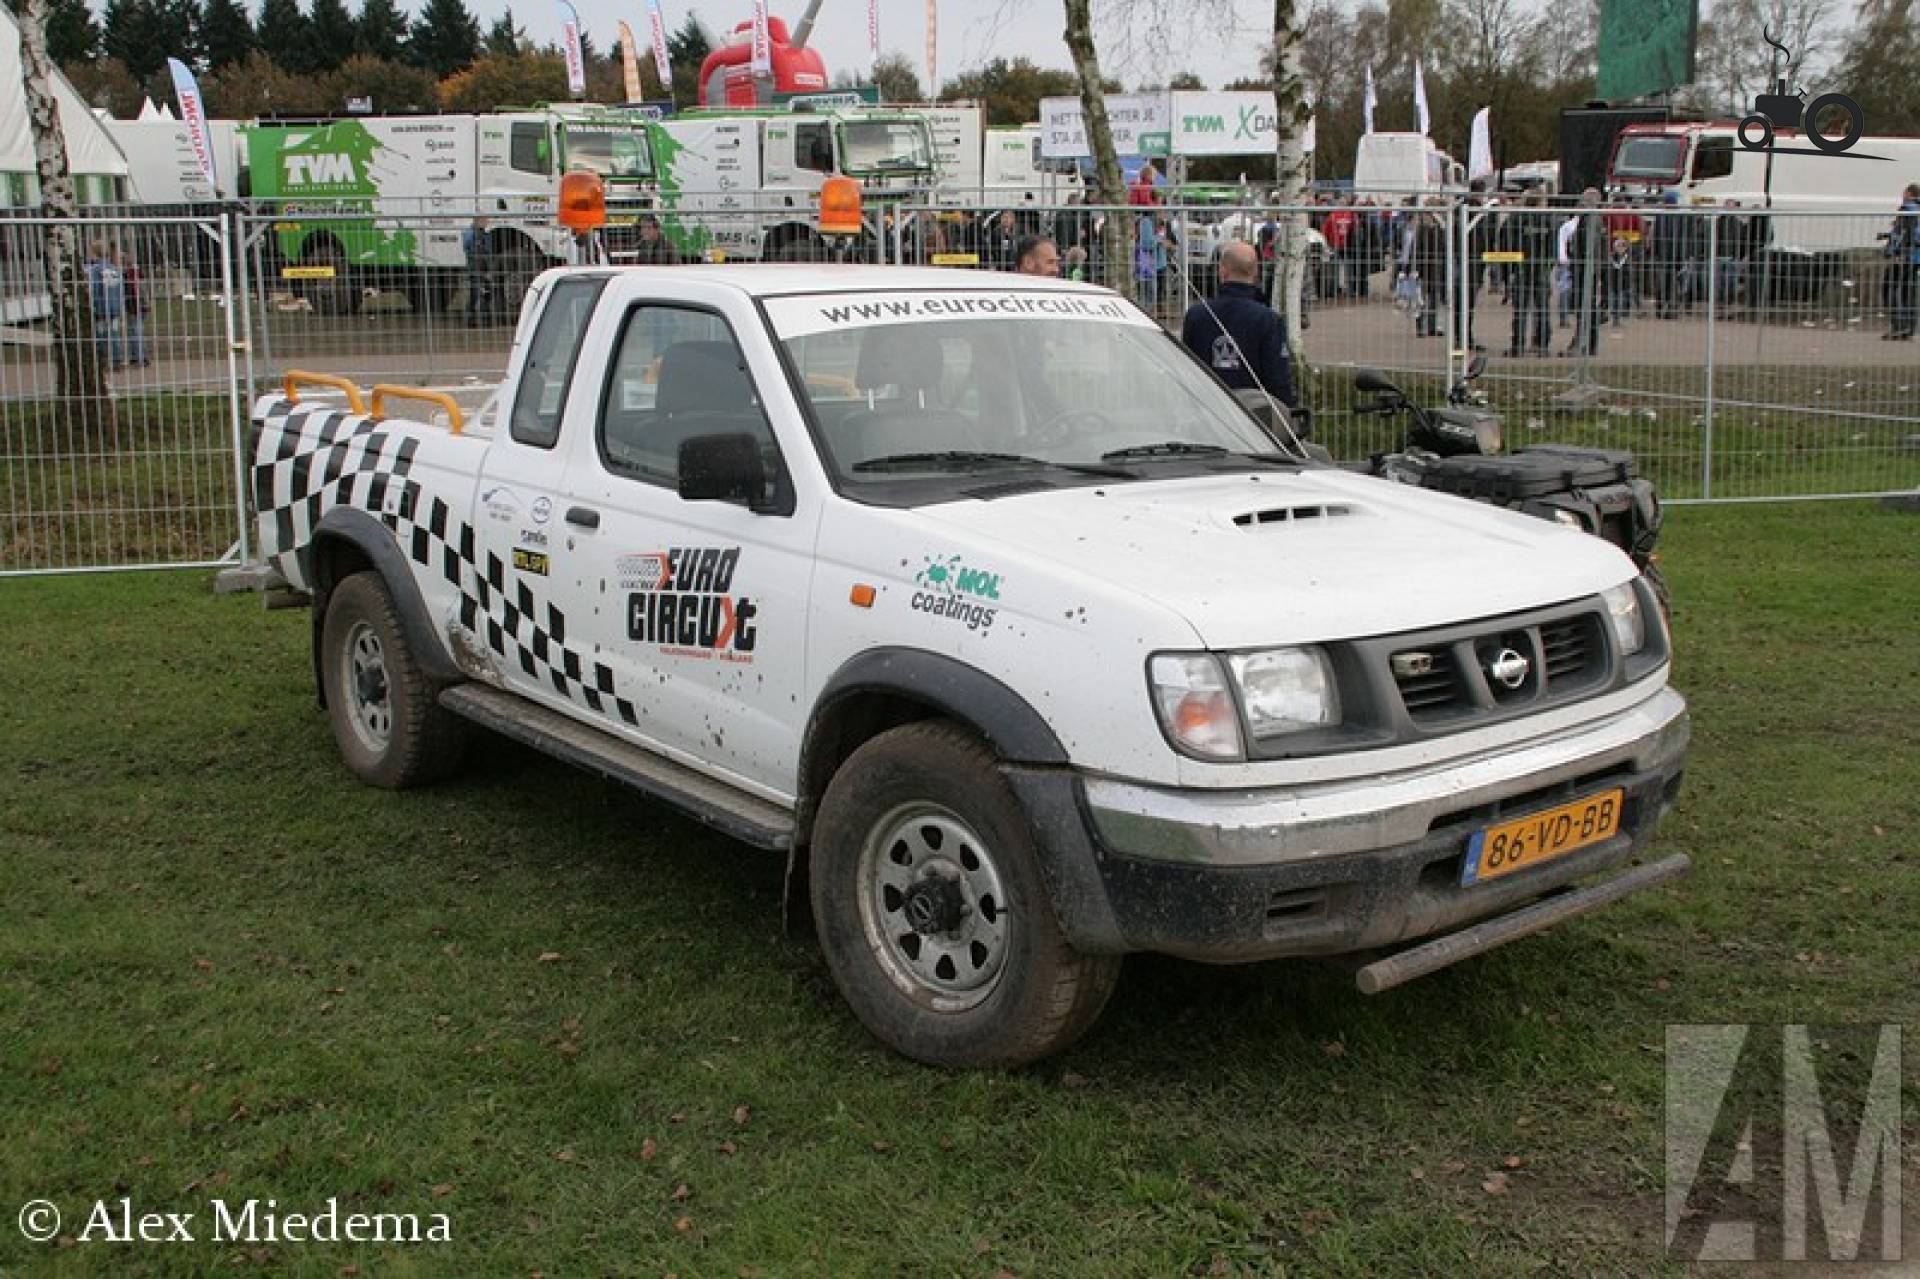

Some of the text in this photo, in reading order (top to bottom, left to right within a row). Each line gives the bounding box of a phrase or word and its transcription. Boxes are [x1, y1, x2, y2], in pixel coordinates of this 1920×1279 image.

[1183, 114, 1225, 133] TVM
[283, 152, 357, 184] TVM
[820, 293, 1127, 323] www.eurocircuit.nl
[956, 565, 999, 600] MOL
[911, 592, 998, 631] coatings
[1487, 798, 1614, 869] 86-VD-BB
